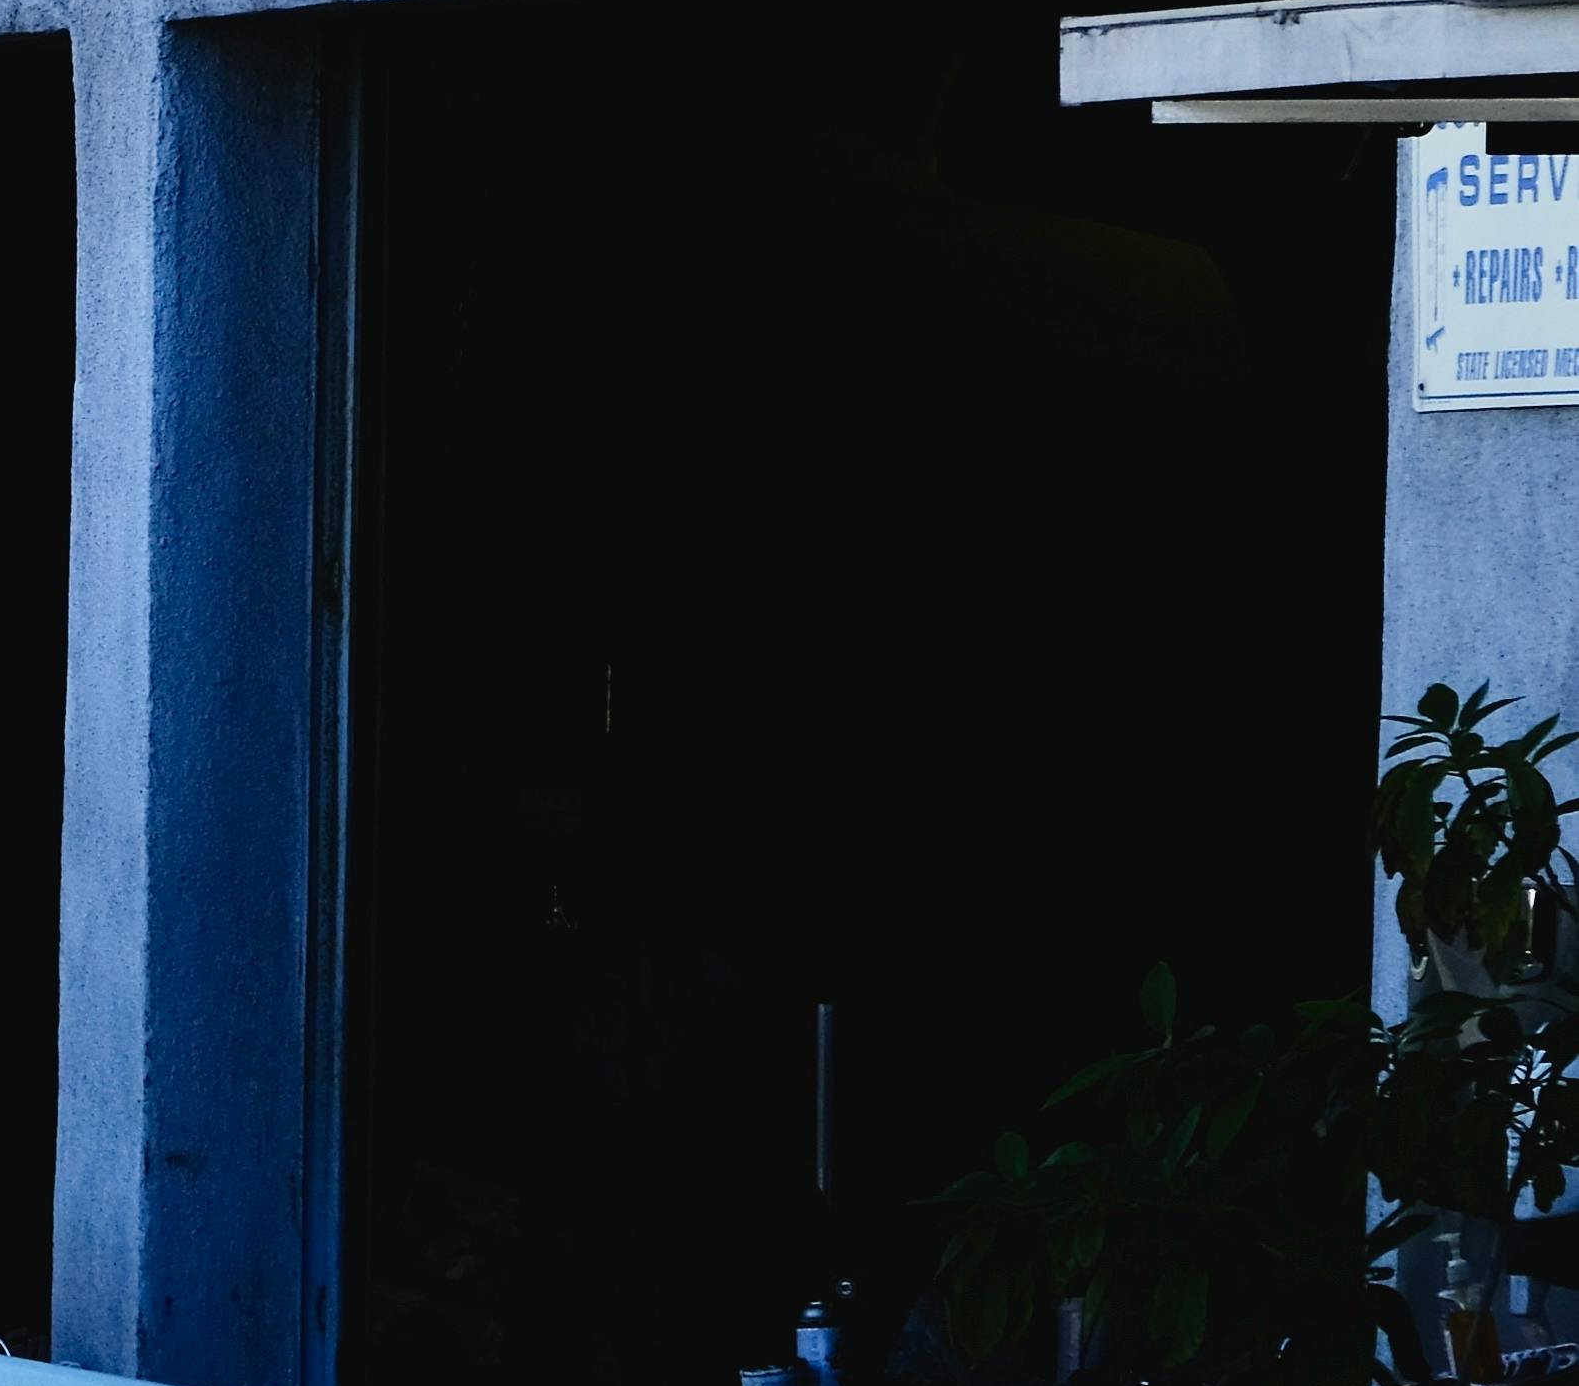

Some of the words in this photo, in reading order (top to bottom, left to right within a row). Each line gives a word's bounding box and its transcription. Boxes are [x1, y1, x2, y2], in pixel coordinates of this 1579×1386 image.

[1465, 246, 1543, 305] REPAIRS
[1456, 351, 1490, 381] STATE
[1493, 348, 1549, 379] LICENSED
